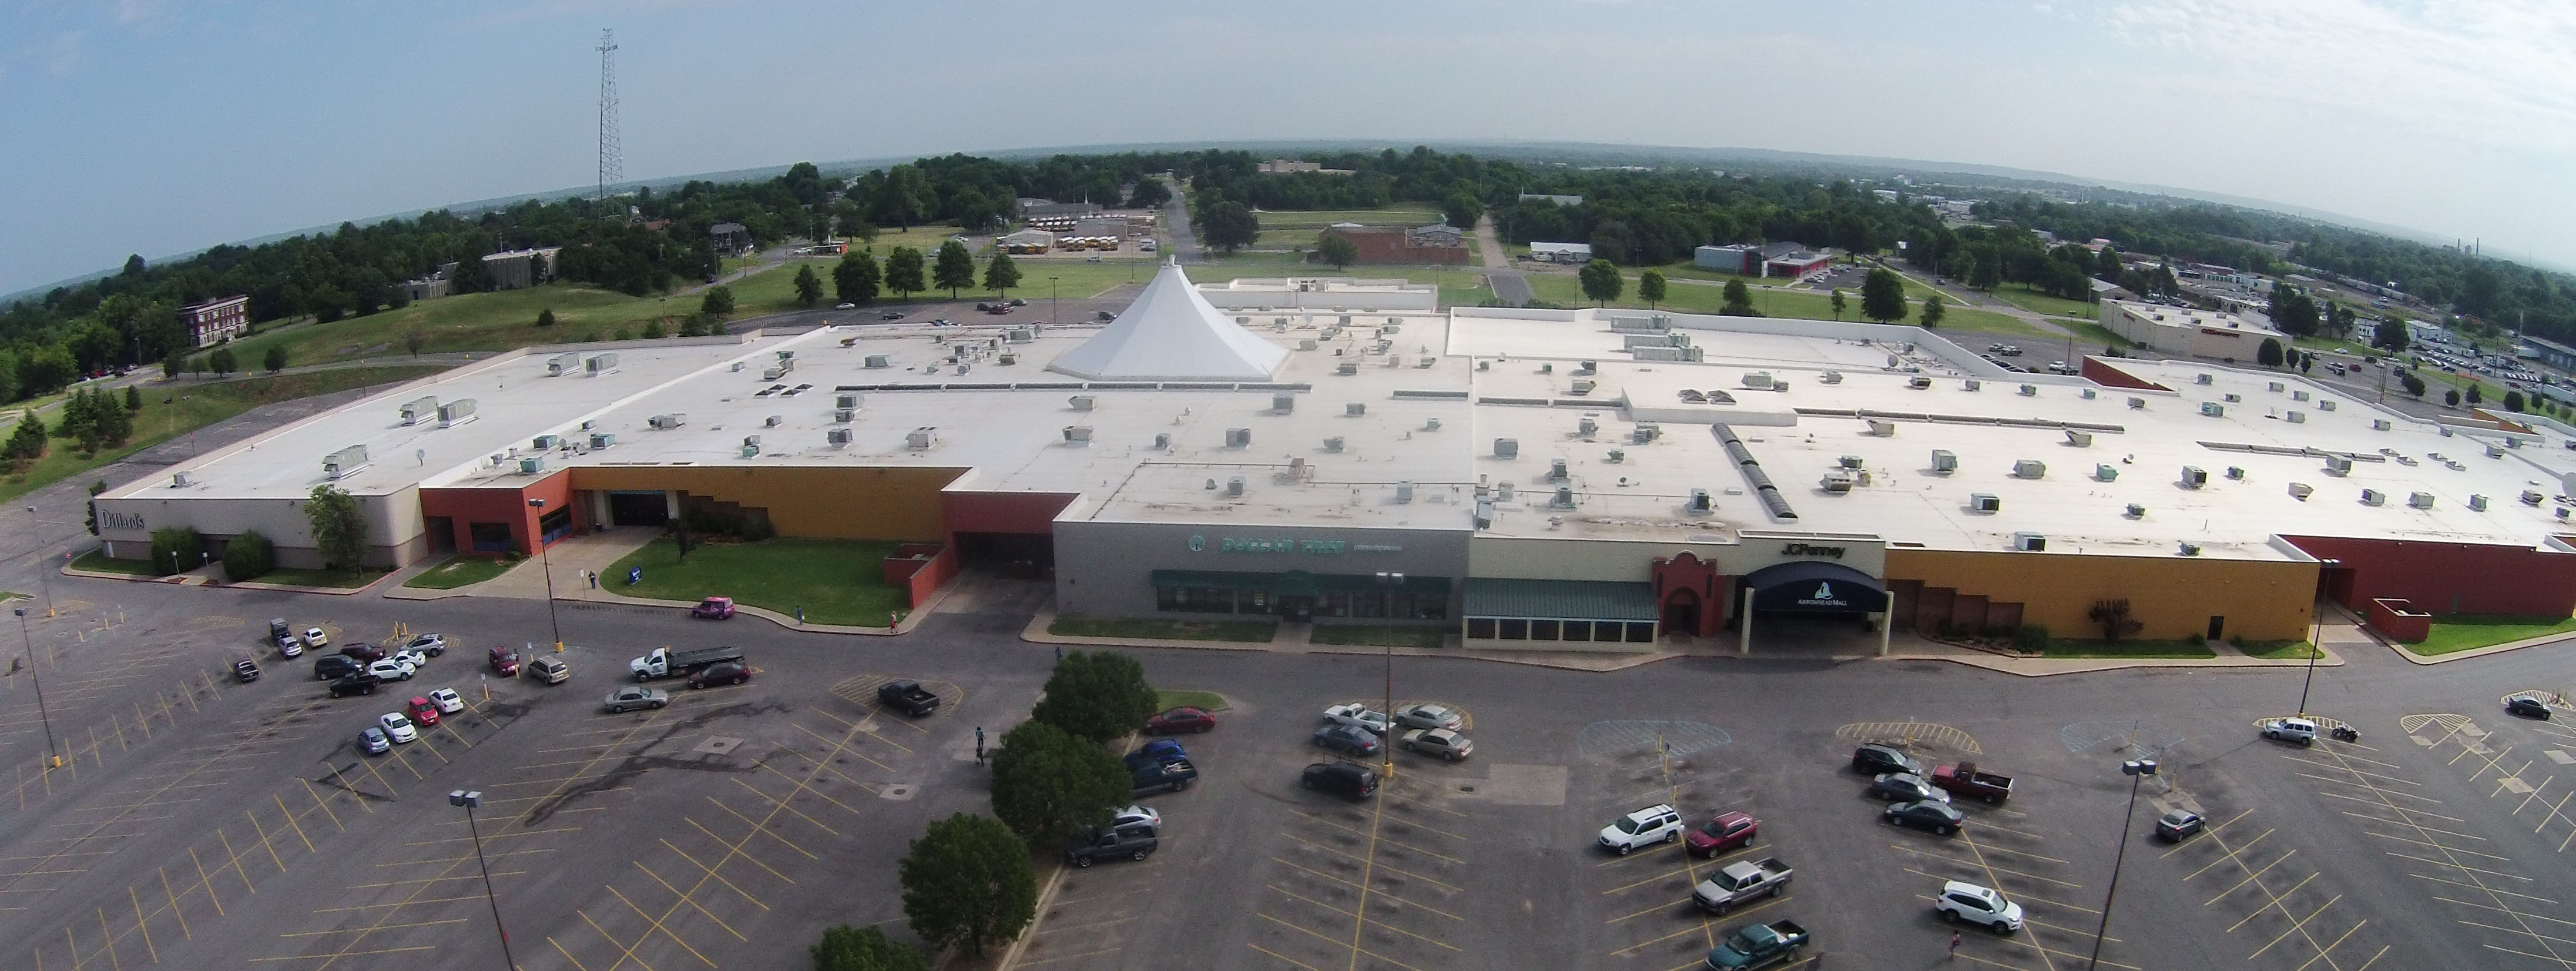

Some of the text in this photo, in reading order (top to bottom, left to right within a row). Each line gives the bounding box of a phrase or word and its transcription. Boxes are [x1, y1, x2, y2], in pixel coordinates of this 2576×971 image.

[101, 510, 145, 528] Dillard's
[1222, 538, 1294, 553] DOLLAR
[1300, 540, 1345, 554] TREE
[1782, 543, 1846, 559] JCPenney
